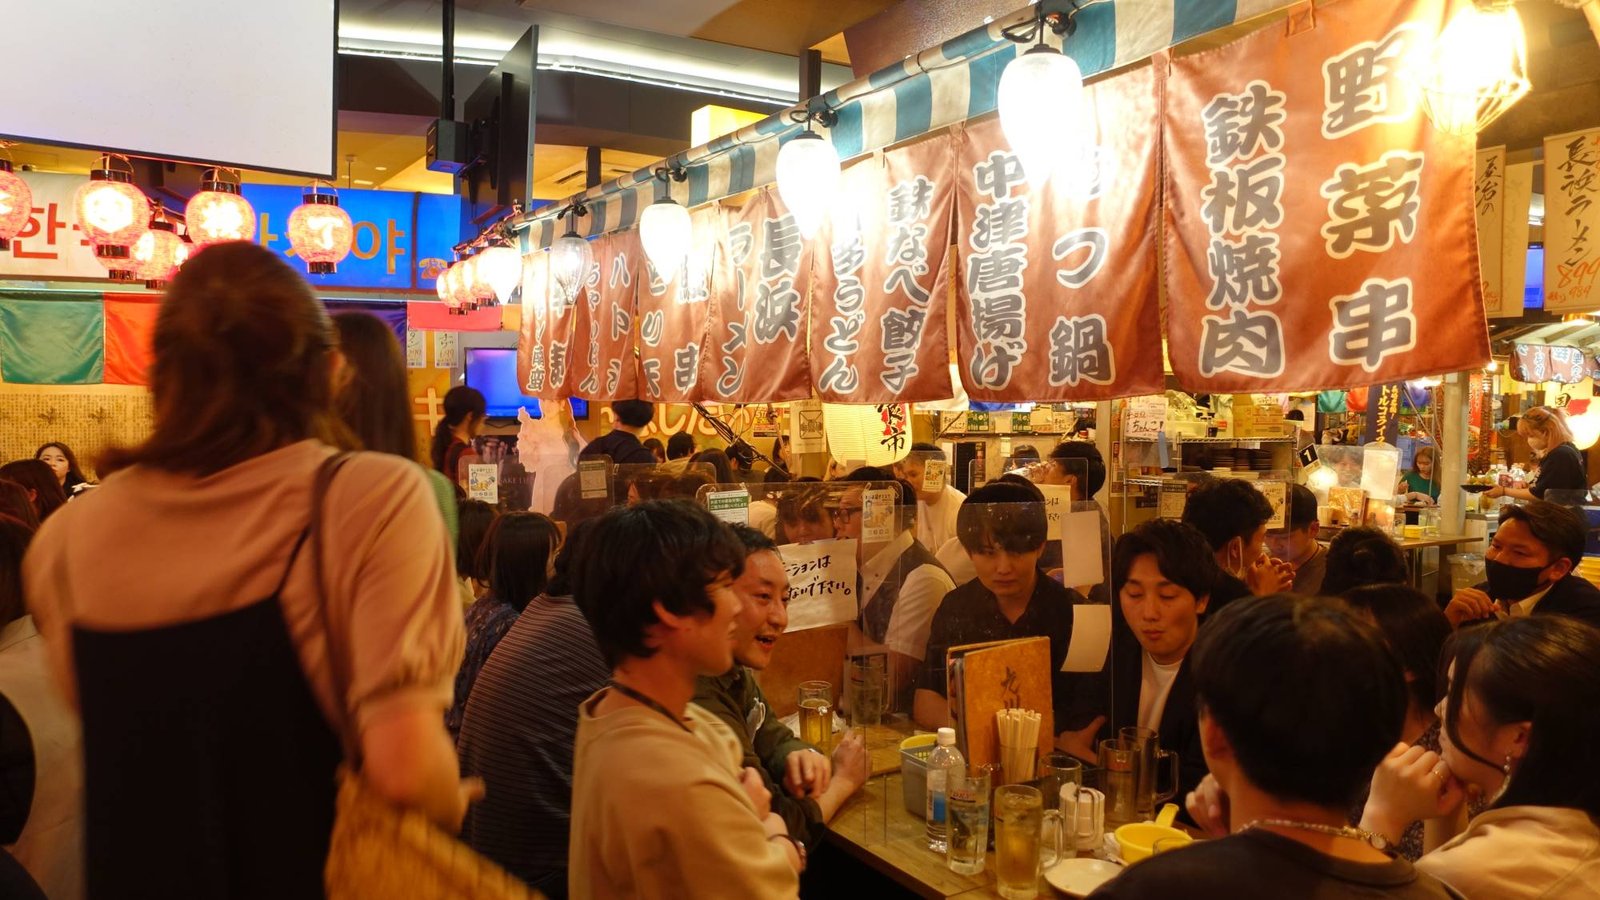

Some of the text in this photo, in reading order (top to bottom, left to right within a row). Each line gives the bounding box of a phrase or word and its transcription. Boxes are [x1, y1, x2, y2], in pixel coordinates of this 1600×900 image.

[753, 212, 803, 345] 長浜
[818, 205, 867, 394] 多うどん
[880, 174, 935, 394] 鉄なべ餃子
[966, 149, 1028, 391] 中津唐揚げ
[1199, 80, 1286, 378] 鉄板焼肉
[1322, 22, 1428, 373] 野菜串
[716, 221, 752, 398] ラーメン
[1304, 449, 1313, 462] 1
